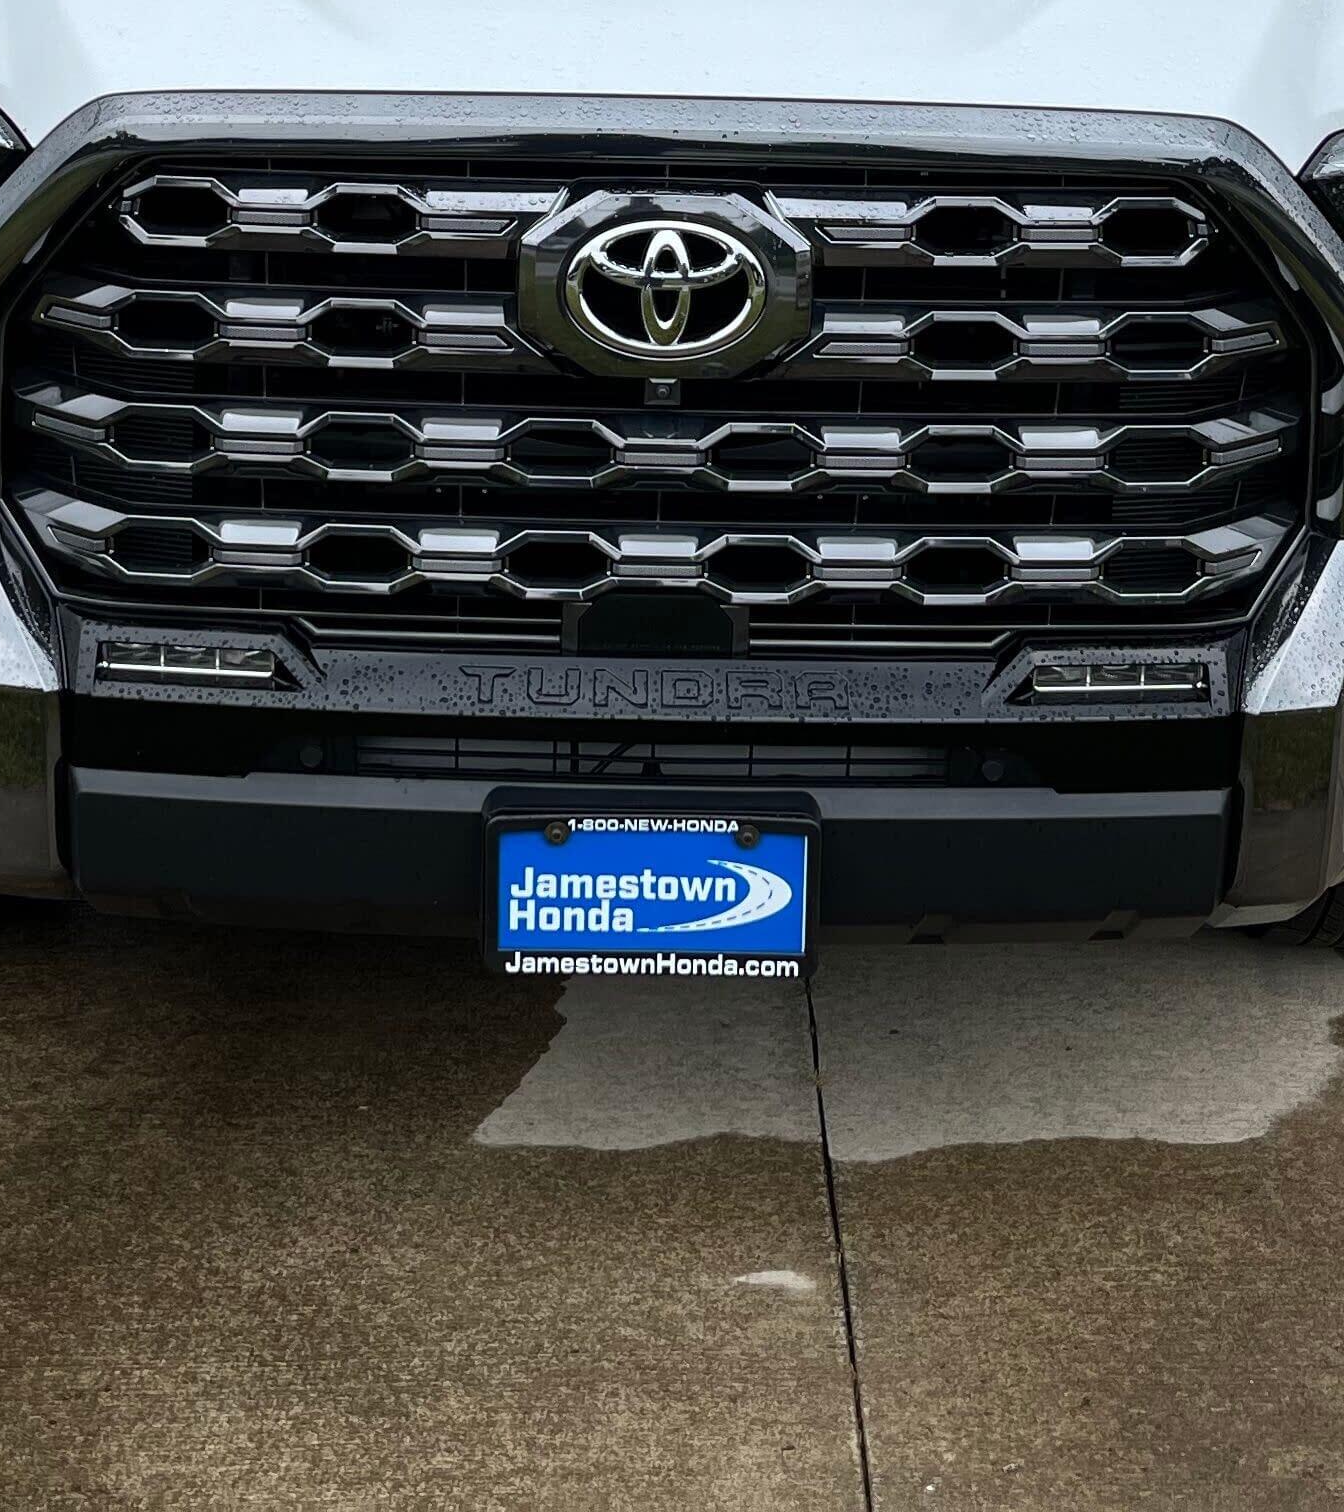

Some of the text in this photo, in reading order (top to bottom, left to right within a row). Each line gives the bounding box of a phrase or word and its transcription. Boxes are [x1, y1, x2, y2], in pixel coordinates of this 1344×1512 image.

[458, 664, 851, 711] TUNDRA
[566, 818, 739, 834] 1-800-NEW-HONDA
[510, 866, 736, 902] Jamestown
[509, 898, 634, 933] Honda
[504, 951, 799, 978] JamestownHonda.com
